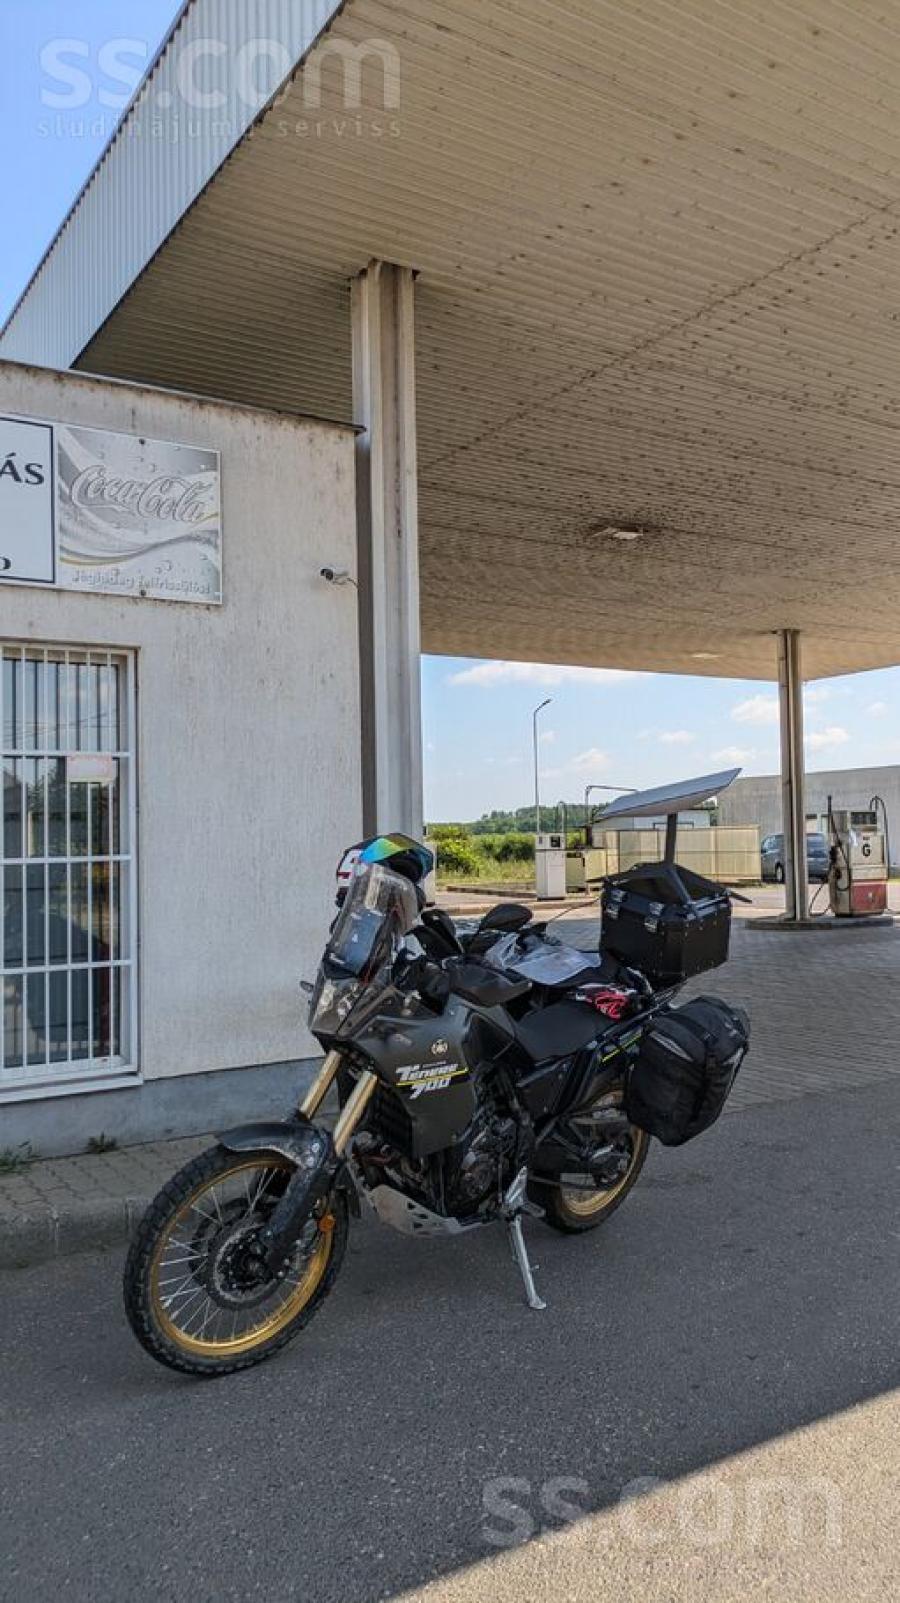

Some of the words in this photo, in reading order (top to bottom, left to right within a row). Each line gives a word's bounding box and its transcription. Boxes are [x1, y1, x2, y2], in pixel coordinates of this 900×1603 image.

[70, 465, 212, 522] Coca-Cola
[862, 843, 871, 857] G
[409, 1076, 452, 1100] 700
